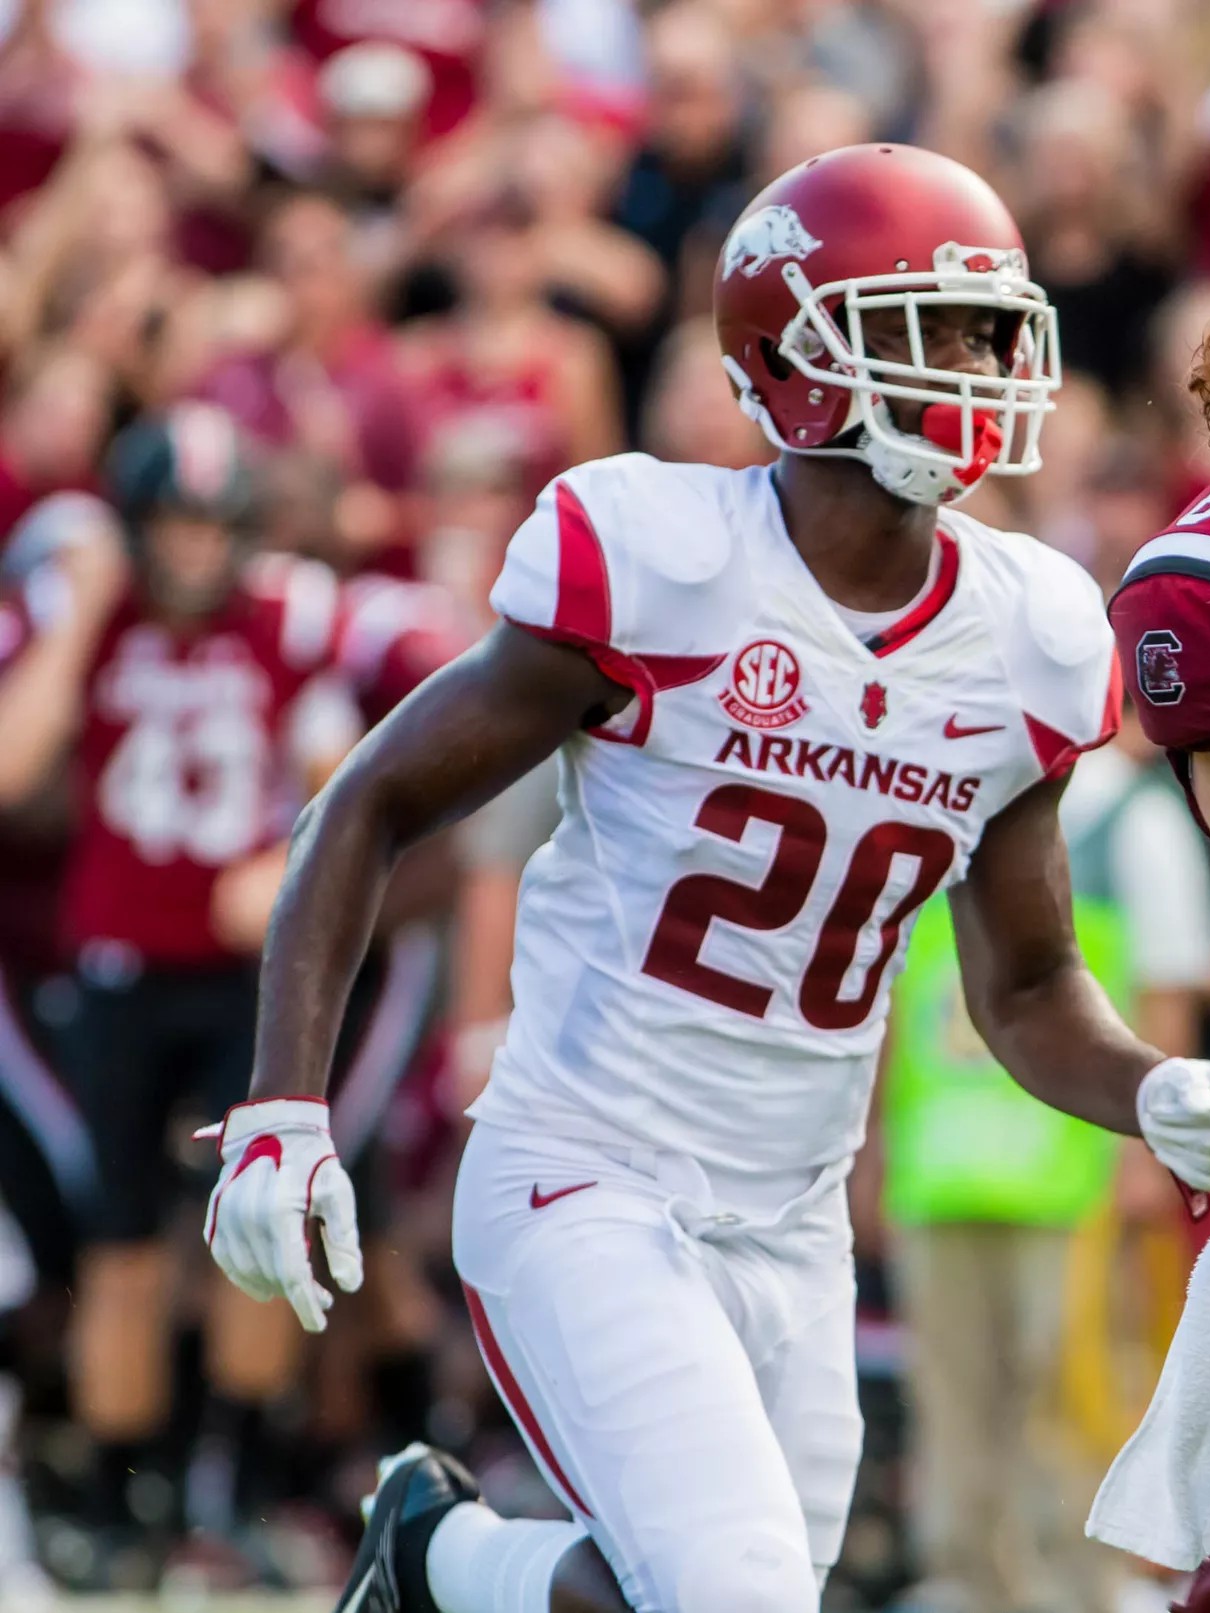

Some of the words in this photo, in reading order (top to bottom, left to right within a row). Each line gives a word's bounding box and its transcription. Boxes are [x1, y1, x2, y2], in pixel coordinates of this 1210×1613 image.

[736, 643, 797, 706] SEC
[728, 700, 797, 728] GRADUATE
[713, 726, 981, 813] ARKANSAS
[638, 782, 956, 1030] 20
